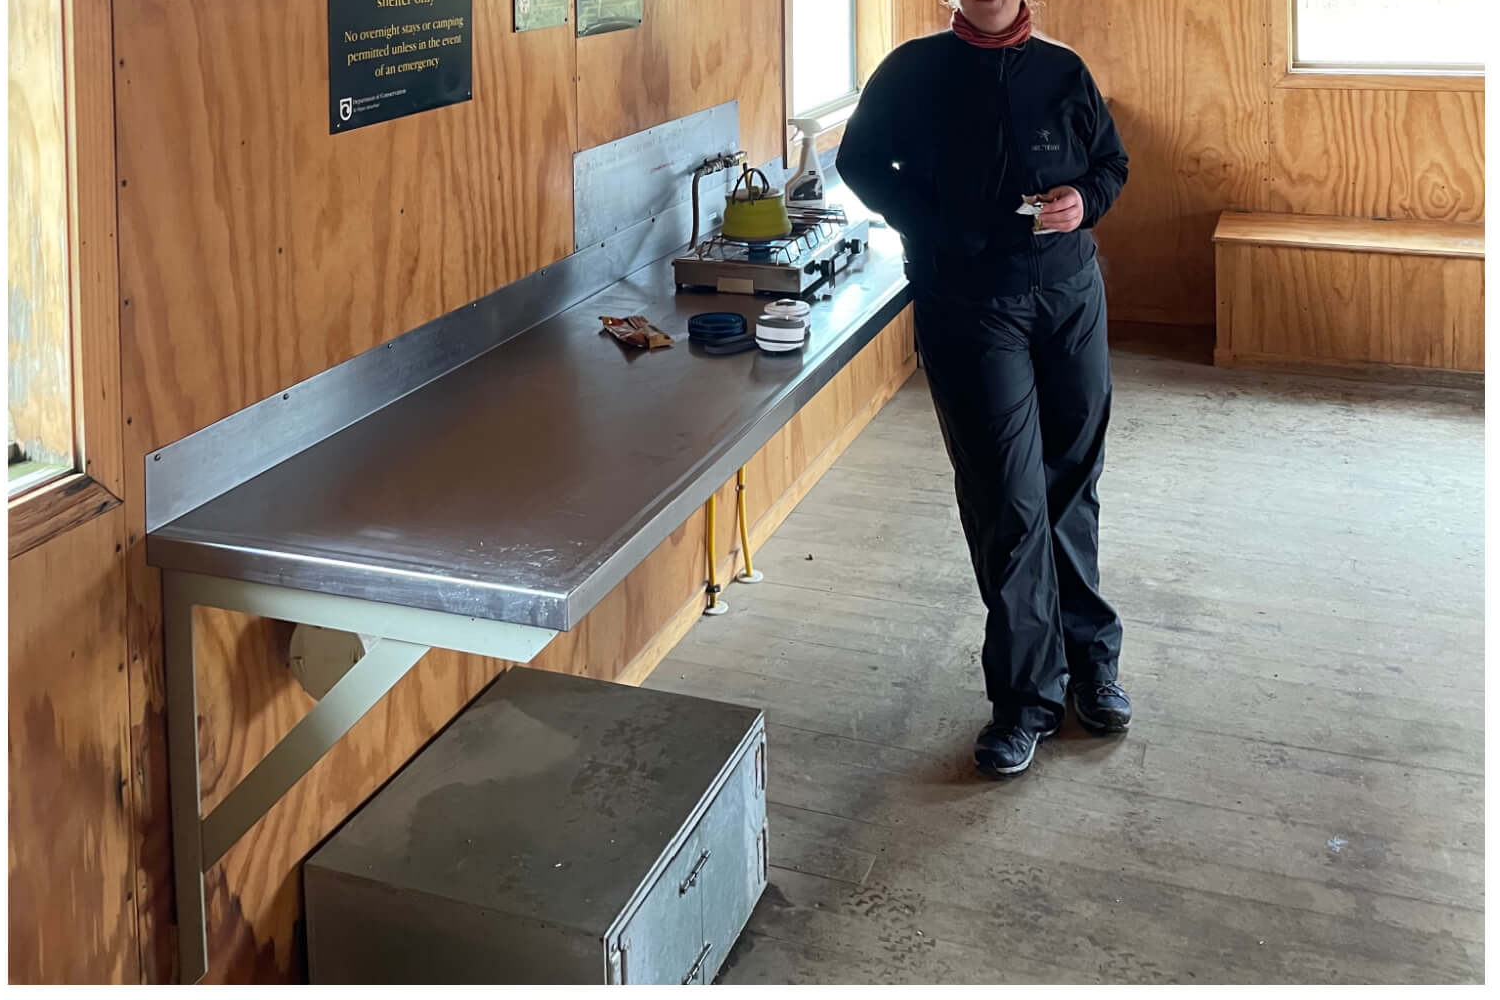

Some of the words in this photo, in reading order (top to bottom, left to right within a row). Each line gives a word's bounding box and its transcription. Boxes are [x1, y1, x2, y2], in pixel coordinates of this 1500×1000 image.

[344, 31, 358, 43] No
[360, 24, 400, 39] overnight
[401, 23, 421, 36] stays
[422, 22, 431, 31] or
[432, 16, 464, 30] camping
[347, 44, 390, 66] permitted
[391, 41, 417, 55] unless
[418, 39, 427, 50] in
[428, 37, 441, 49] the
[441, 34, 462, 47] event
[374, 63, 386, 77] of
[386, 65, 397, 75] an
[397, 57, 440, 72] emergency
